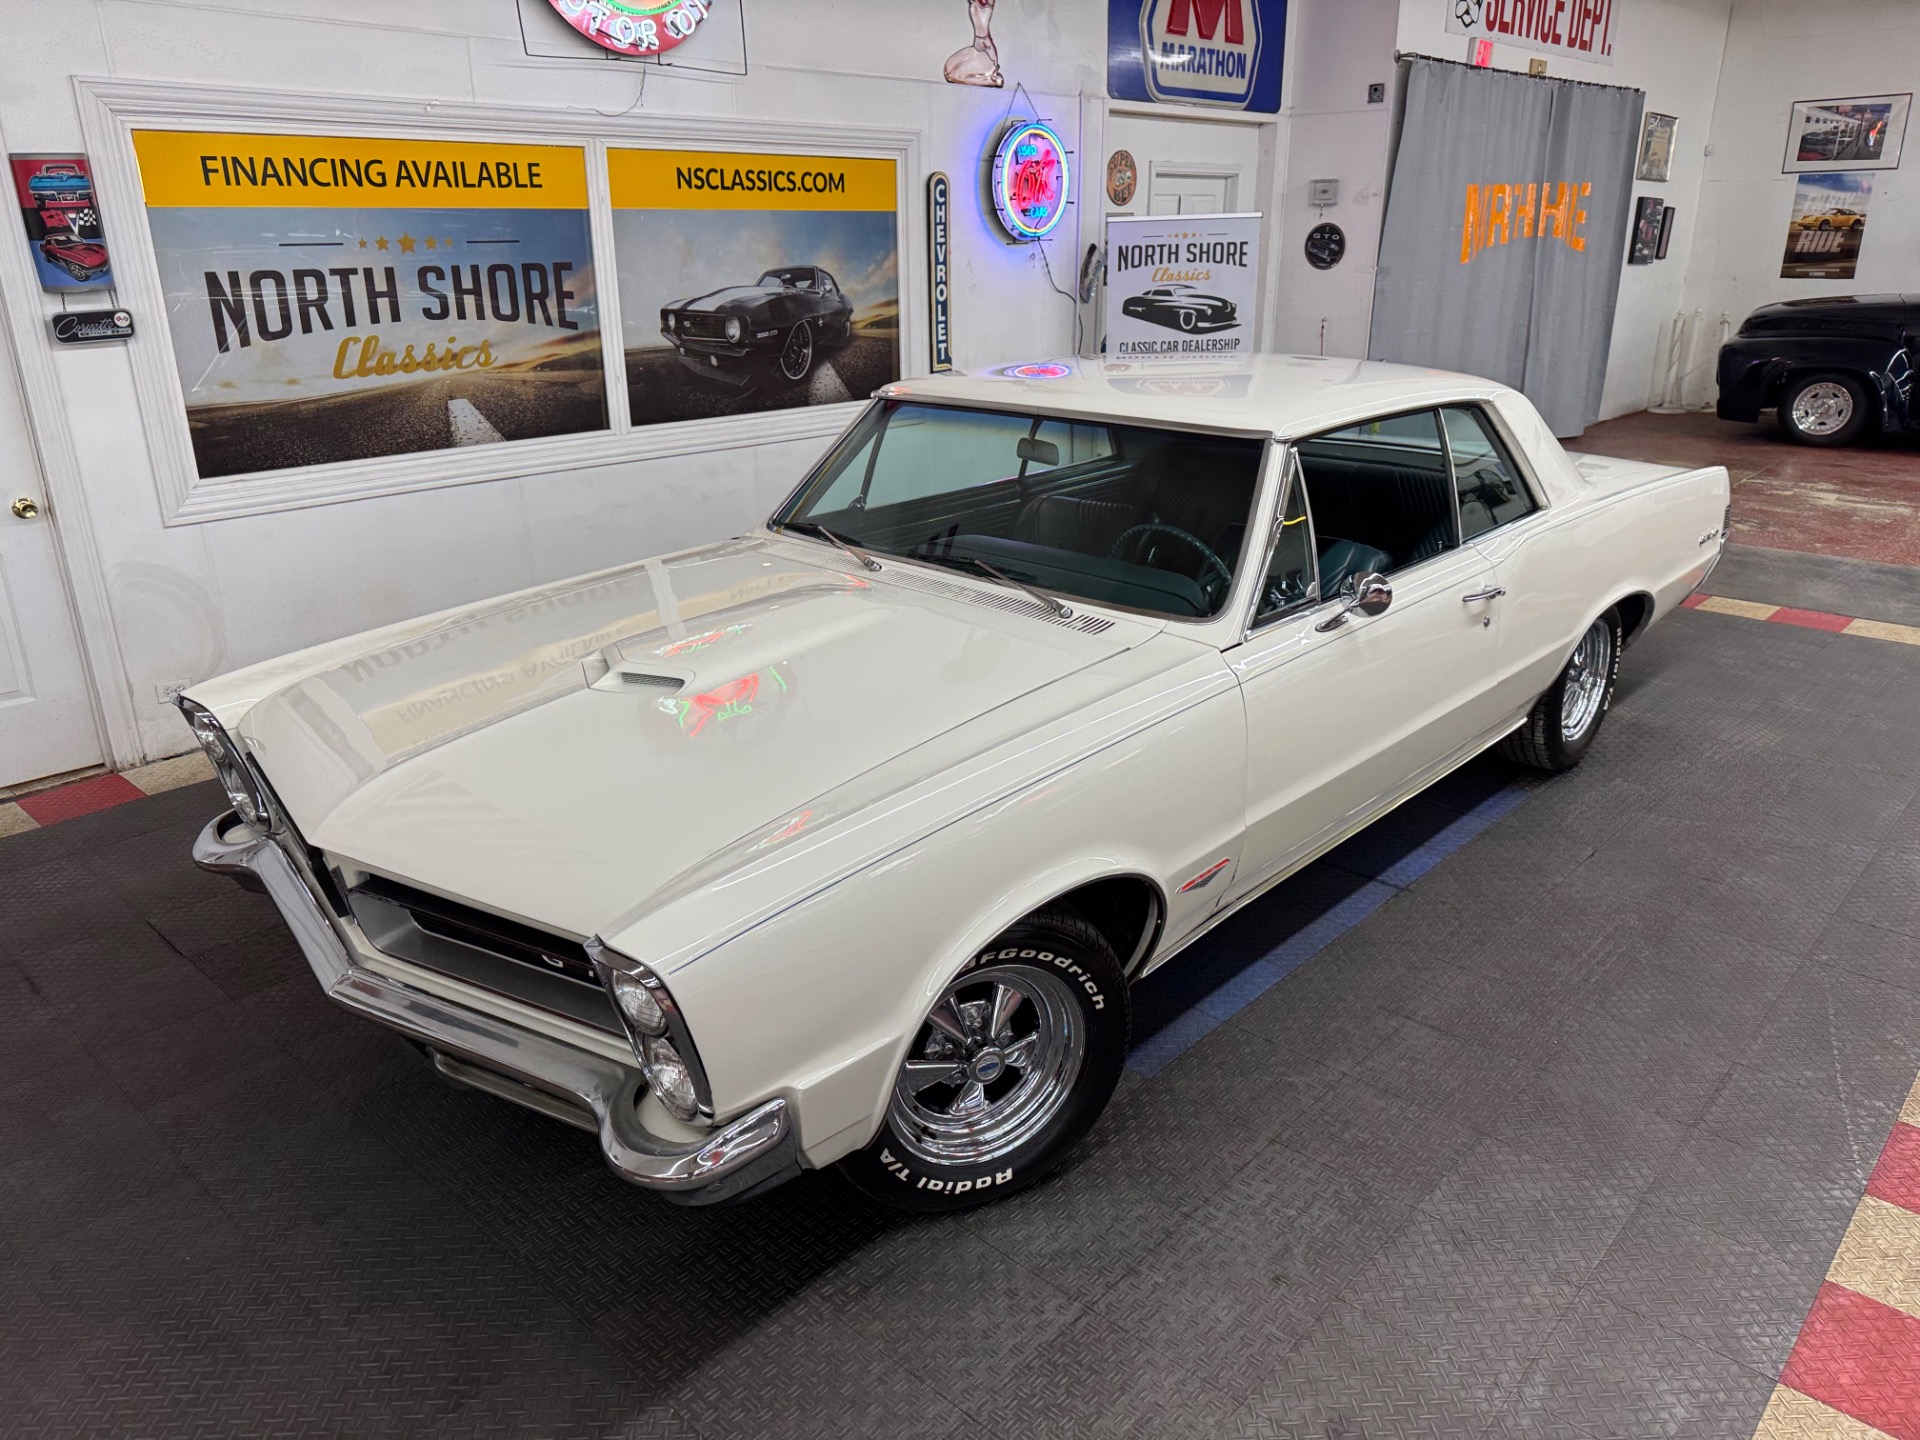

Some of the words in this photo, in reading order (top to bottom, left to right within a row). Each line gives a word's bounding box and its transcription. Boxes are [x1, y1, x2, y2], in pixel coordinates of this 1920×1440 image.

[1159, 42, 1247, 79] MARATHON
[200, 156, 387, 187] FINANCING
[395, 160, 543, 189] AVAILABLE
[676, 167, 845, 193] NSCLASSICS.COM
[1113, 184, 1133, 203] BEE
[1313, 233, 1340, 241] GTO
[1795, 230, 1845, 252] RIDE
[1117, 243, 1180, 272] NORTH
[1186, 241, 1249, 268] SHORE
[935, 184, 948, 361] CHEVROLET
[1151, 267, 1212, 283] Classics
[204, 266, 401, 354] NORTH
[418, 261, 579, 331] SHORE
[56, 316, 117, 338] Corvette
[332, 334, 498, 380] Classics
[1119, 341, 1157, 353] CLASSIC
[1160, 341, 1179, 353] CAR
[1182, 338, 1241, 352] DEALERSHIP
[879, 1148, 909, 1182] T/A
[917, 1167, 1013, 1194] Radial
